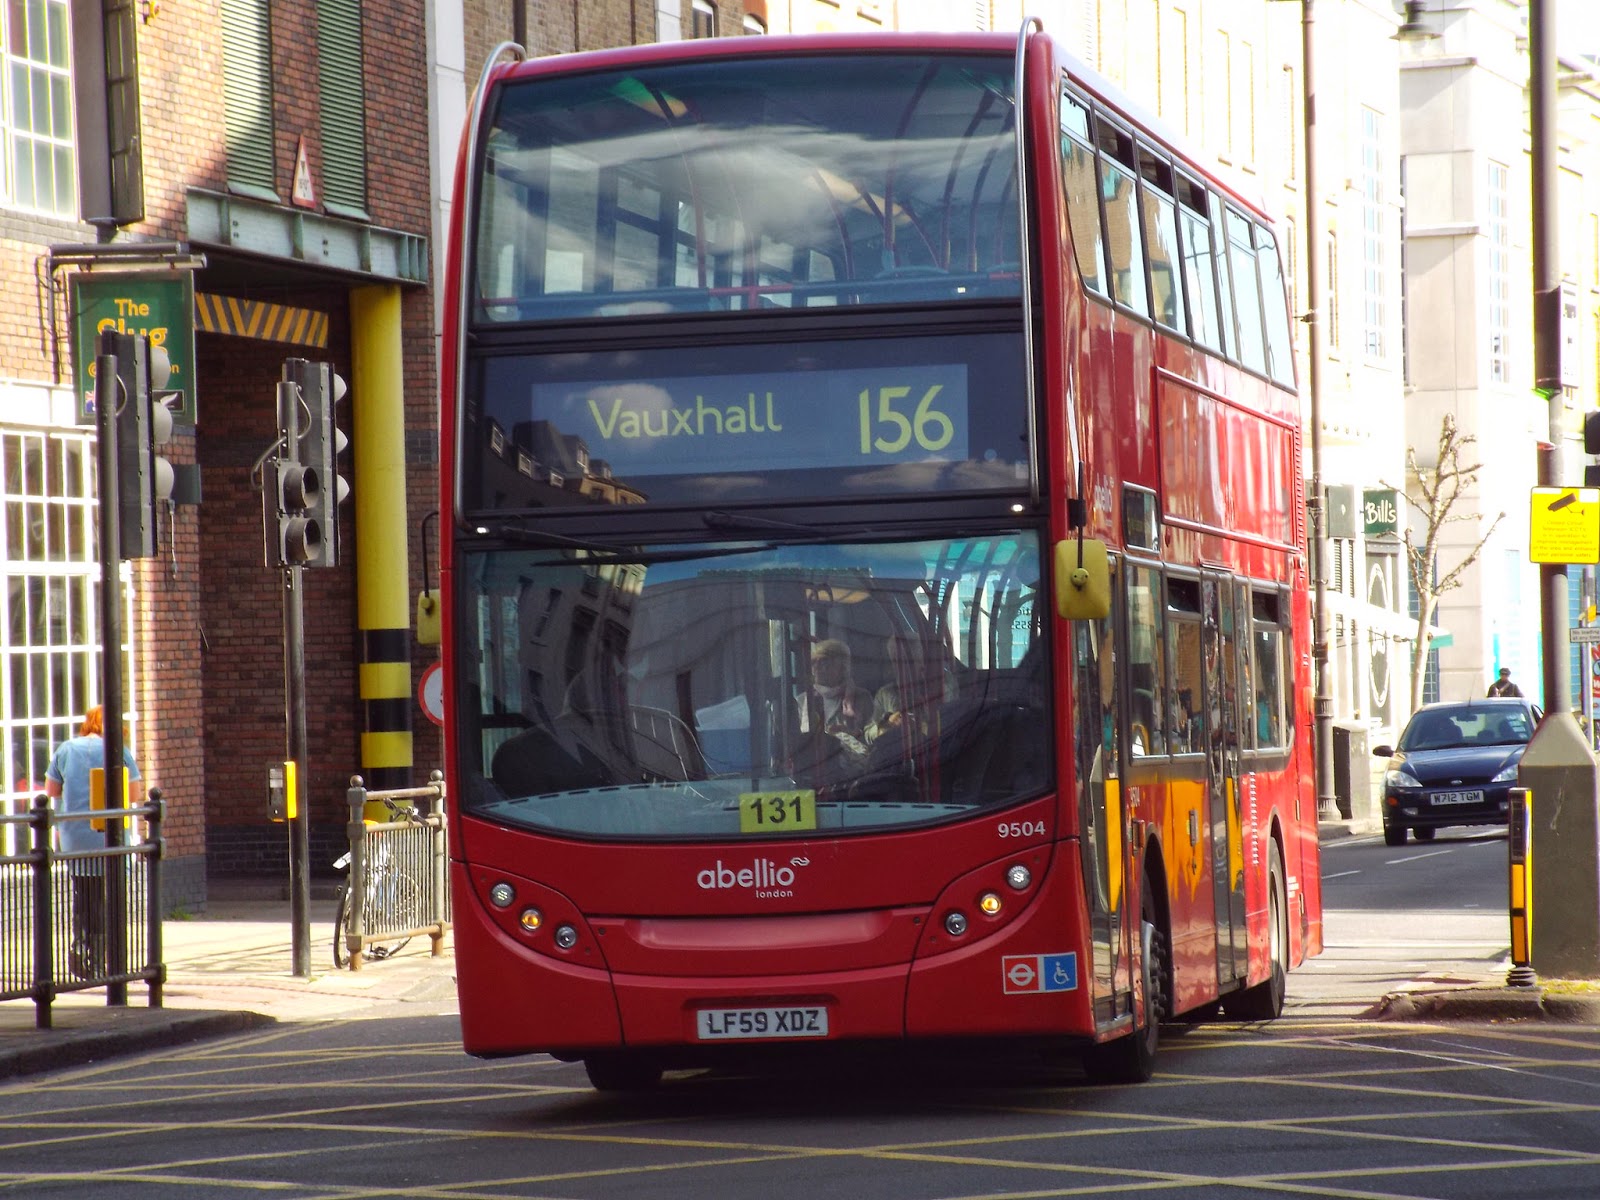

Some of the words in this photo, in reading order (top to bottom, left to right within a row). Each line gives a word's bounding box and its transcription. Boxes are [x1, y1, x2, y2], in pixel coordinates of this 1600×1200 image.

[114, 298, 150, 316] The
[587, 391, 783, 440] Vauxhall
[858, 384, 955, 455] 156
[1365, 499, 1397, 525] Bill's
[750, 796, 802, 824] 131
[1433, 793, 1457, 803] W712
[1459, 792, 1481, 802] TGM
[997, 820, 1046, 838] 9504
[697, 858, 795, 889] abellio
[755, 889, 794, 899] london
[707, 1011, 769, 1035] LF59
[775, 1009, 820, 1033] XDZ
